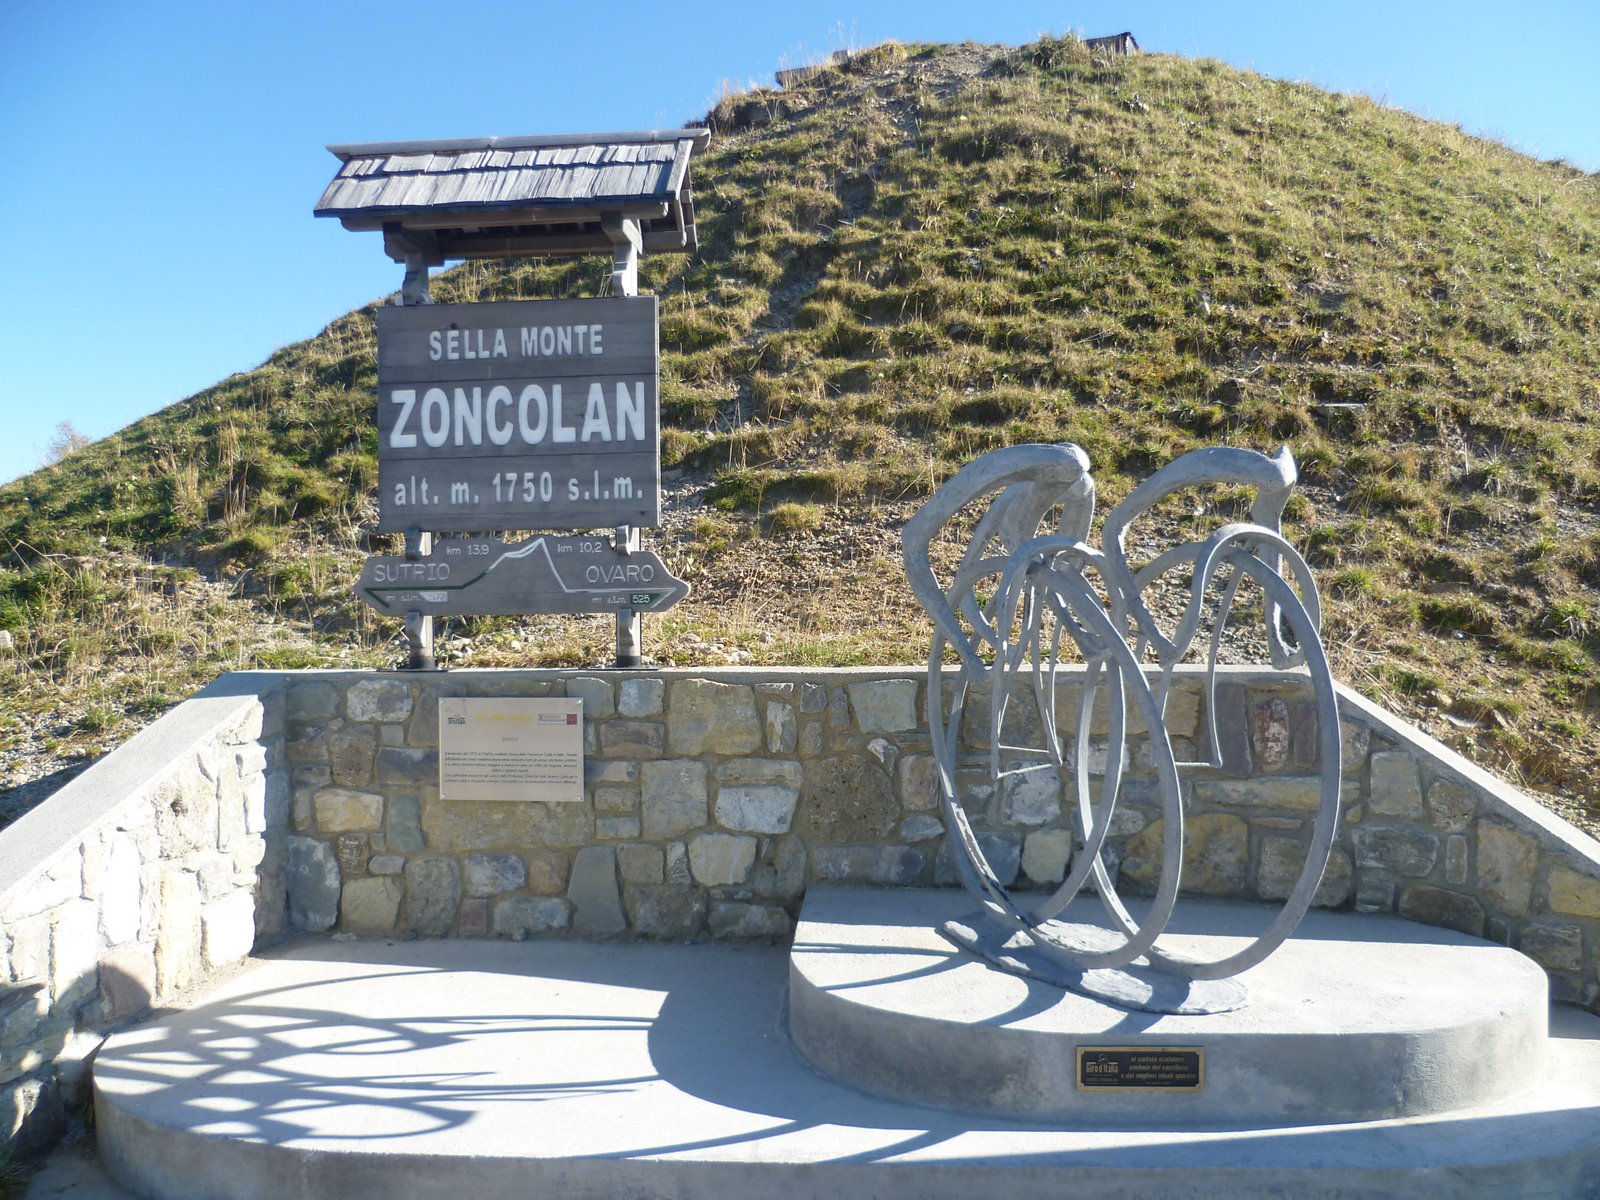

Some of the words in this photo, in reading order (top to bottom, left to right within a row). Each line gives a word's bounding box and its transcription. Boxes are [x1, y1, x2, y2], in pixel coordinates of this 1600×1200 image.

[429, 329, 507, 361] SELLA
[521, 325, 603, 357] MONTE
[390, 382, 645, 448] ZONCOLAN
[395, 476, 439, 506] alt.
[451, 481, 479, 504] m.
[492, 471, 552, 502] 1750
[568, 470, 643, 501] s.l.m.
[446, 546, 461, 556] km
[557, 544, 573, 553] km
[374, 563, 450, 582] SUTRIO
[586, 564, 654, 583] OVARO
[632, 594, 651, 603] 525
